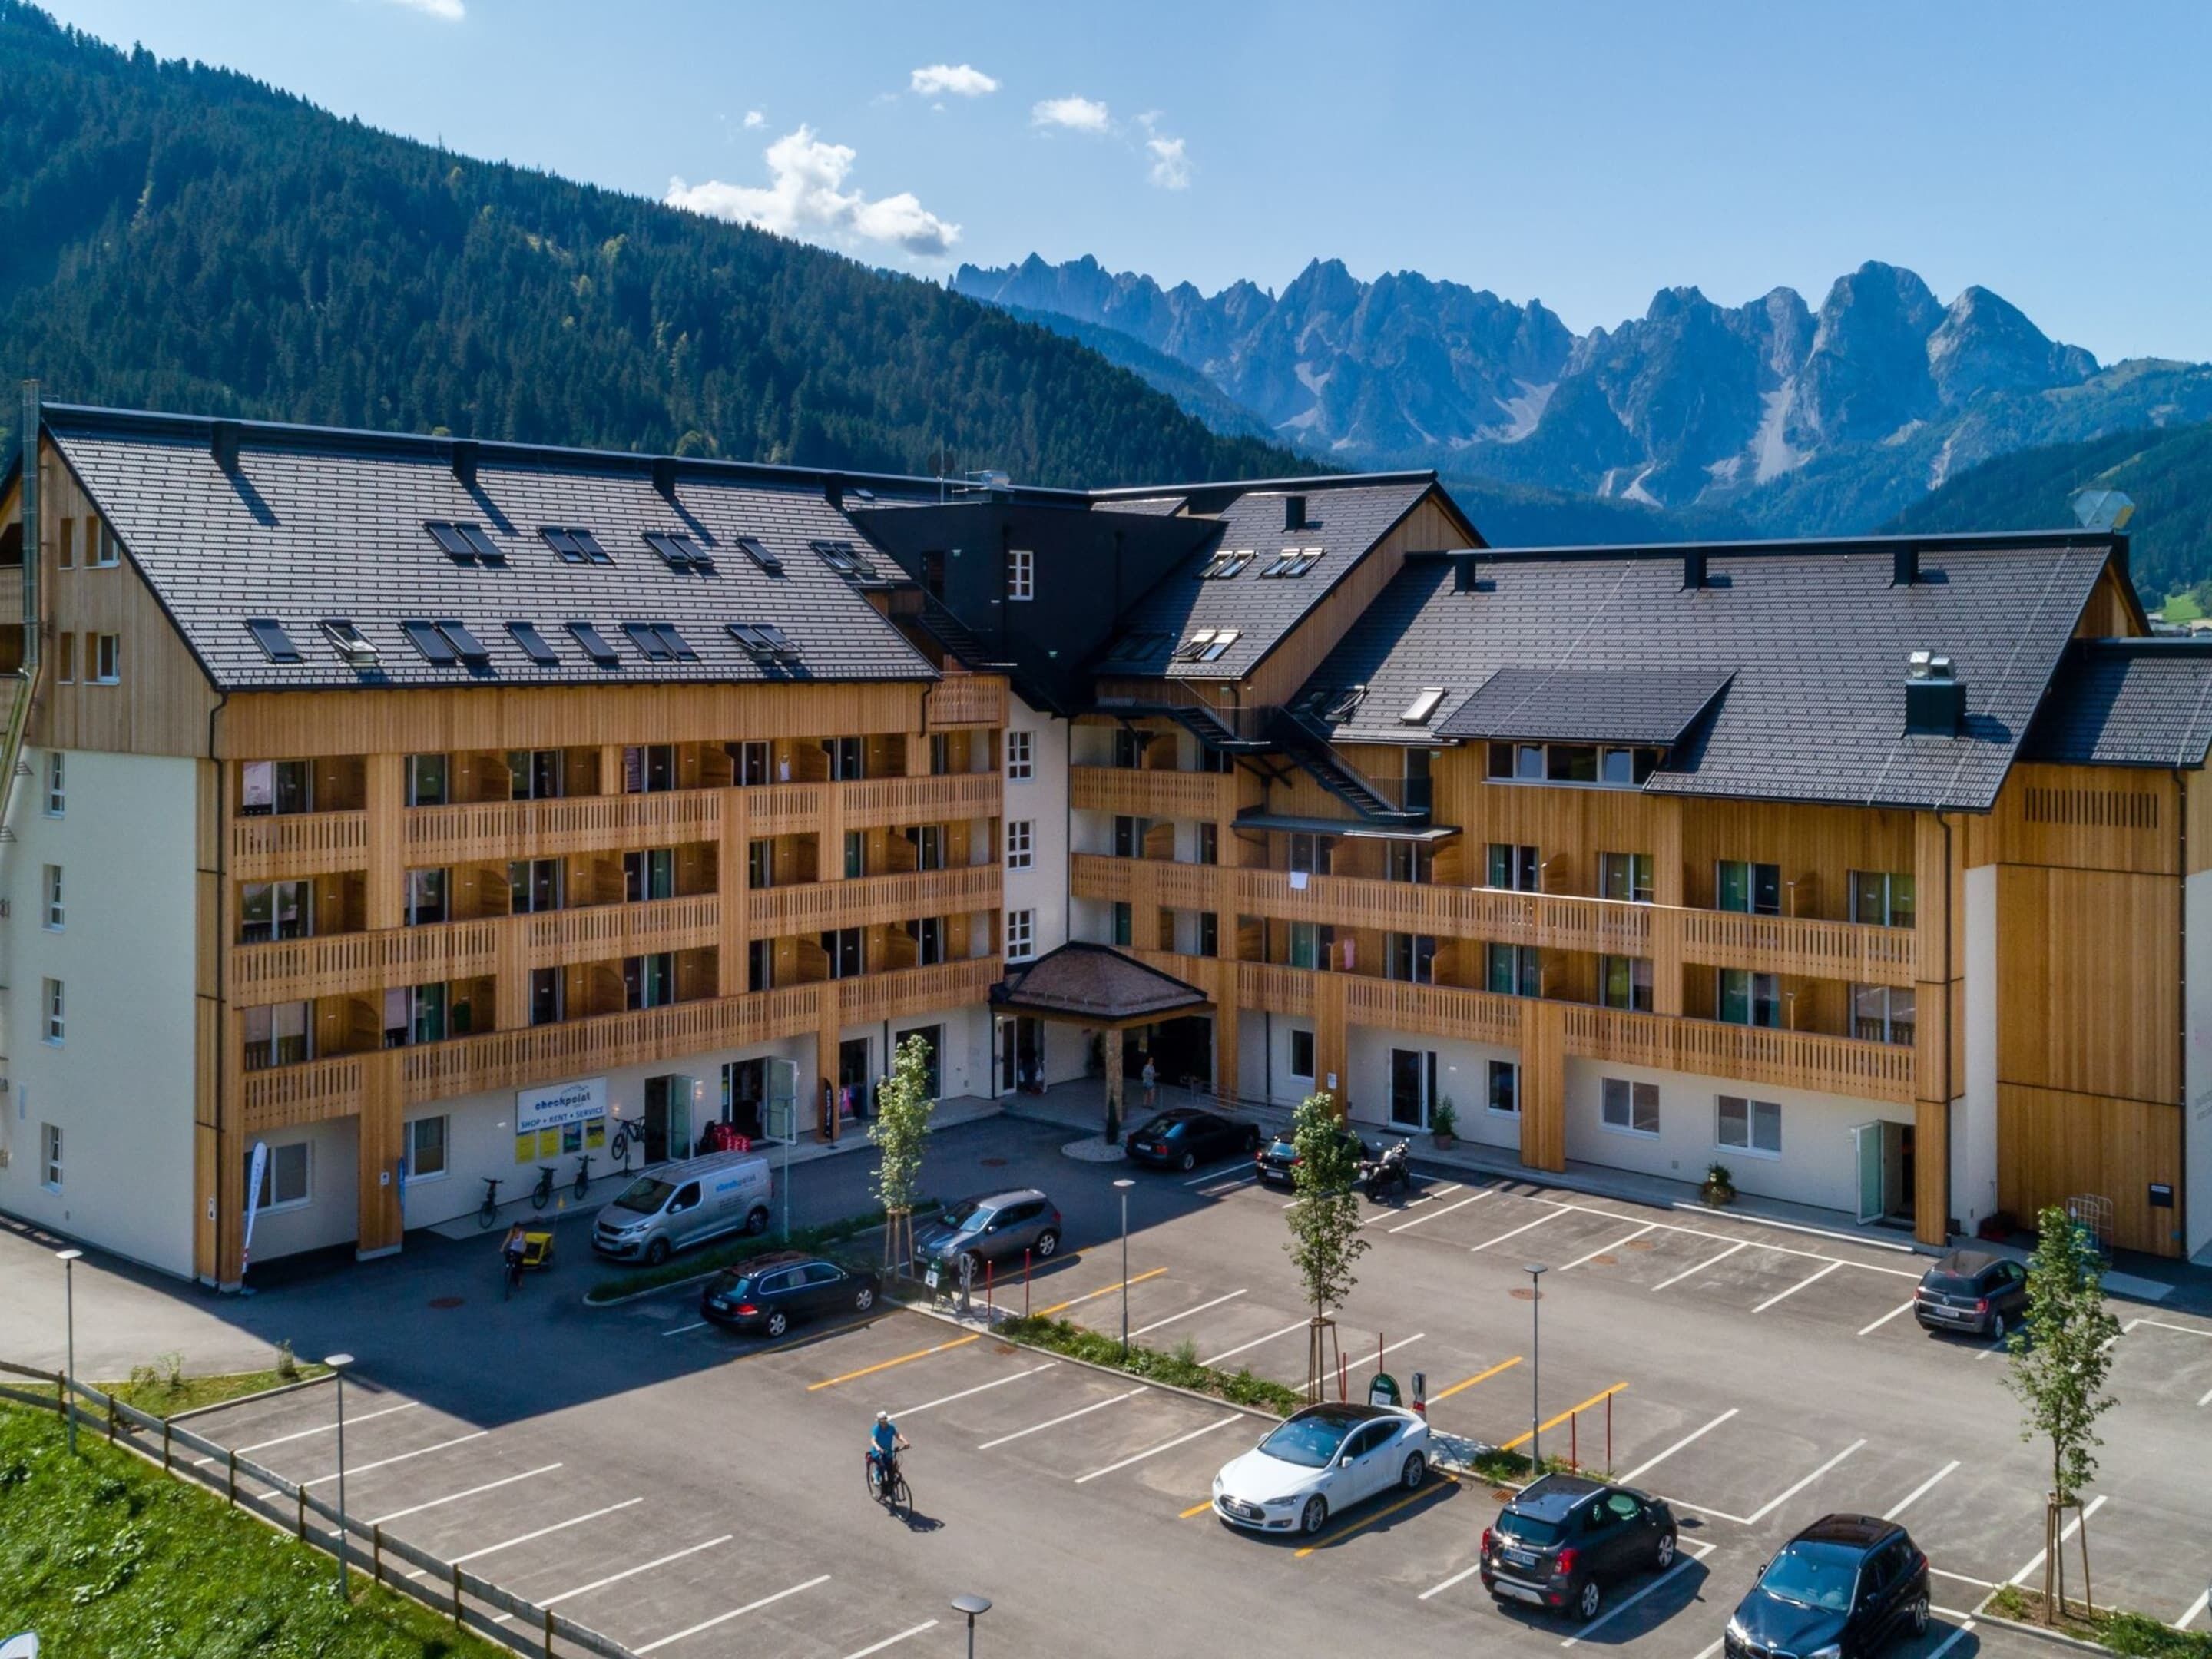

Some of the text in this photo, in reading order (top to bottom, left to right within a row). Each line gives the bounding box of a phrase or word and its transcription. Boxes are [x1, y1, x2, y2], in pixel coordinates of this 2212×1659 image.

[521, 1106, 604, 1128] SHOP RENT SERVICE
